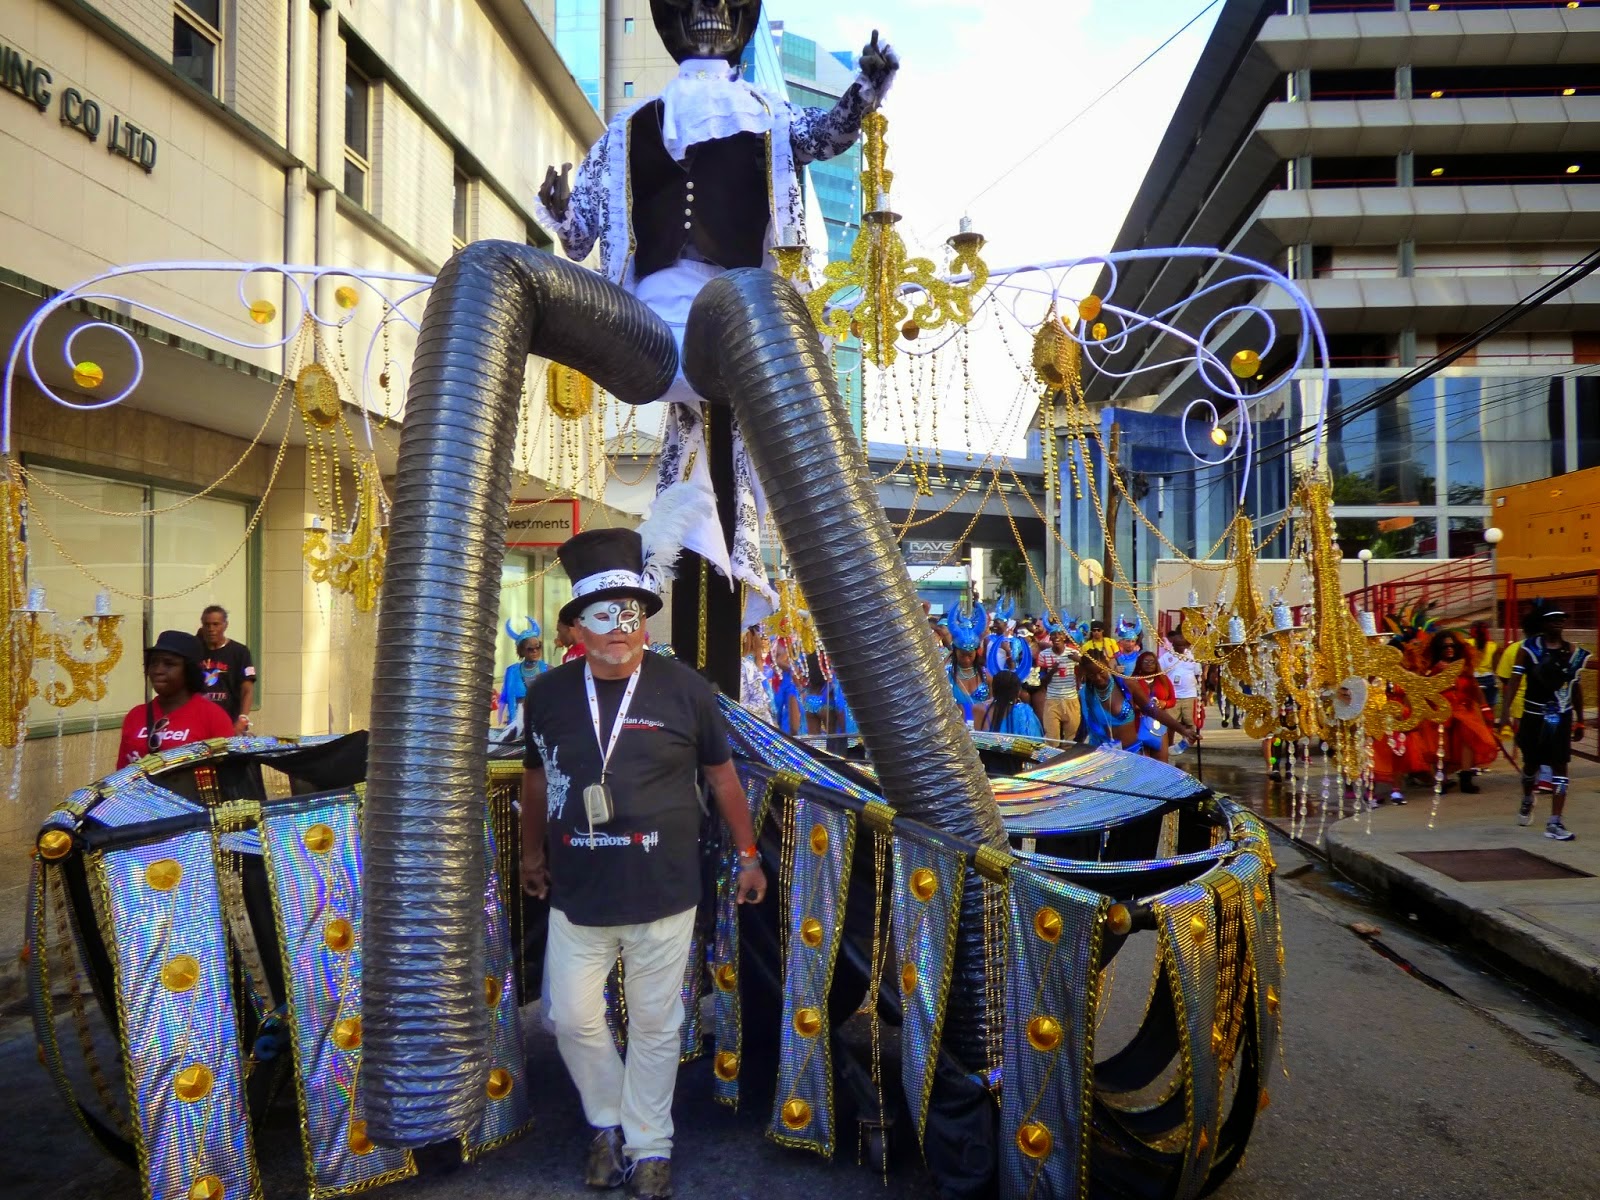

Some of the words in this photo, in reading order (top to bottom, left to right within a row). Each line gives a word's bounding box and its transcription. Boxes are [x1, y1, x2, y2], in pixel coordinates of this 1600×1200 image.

[0, 43, 52, 109] ING
[61, 87, 101, 139] CO
[108, 115, 157, 173] LTD
